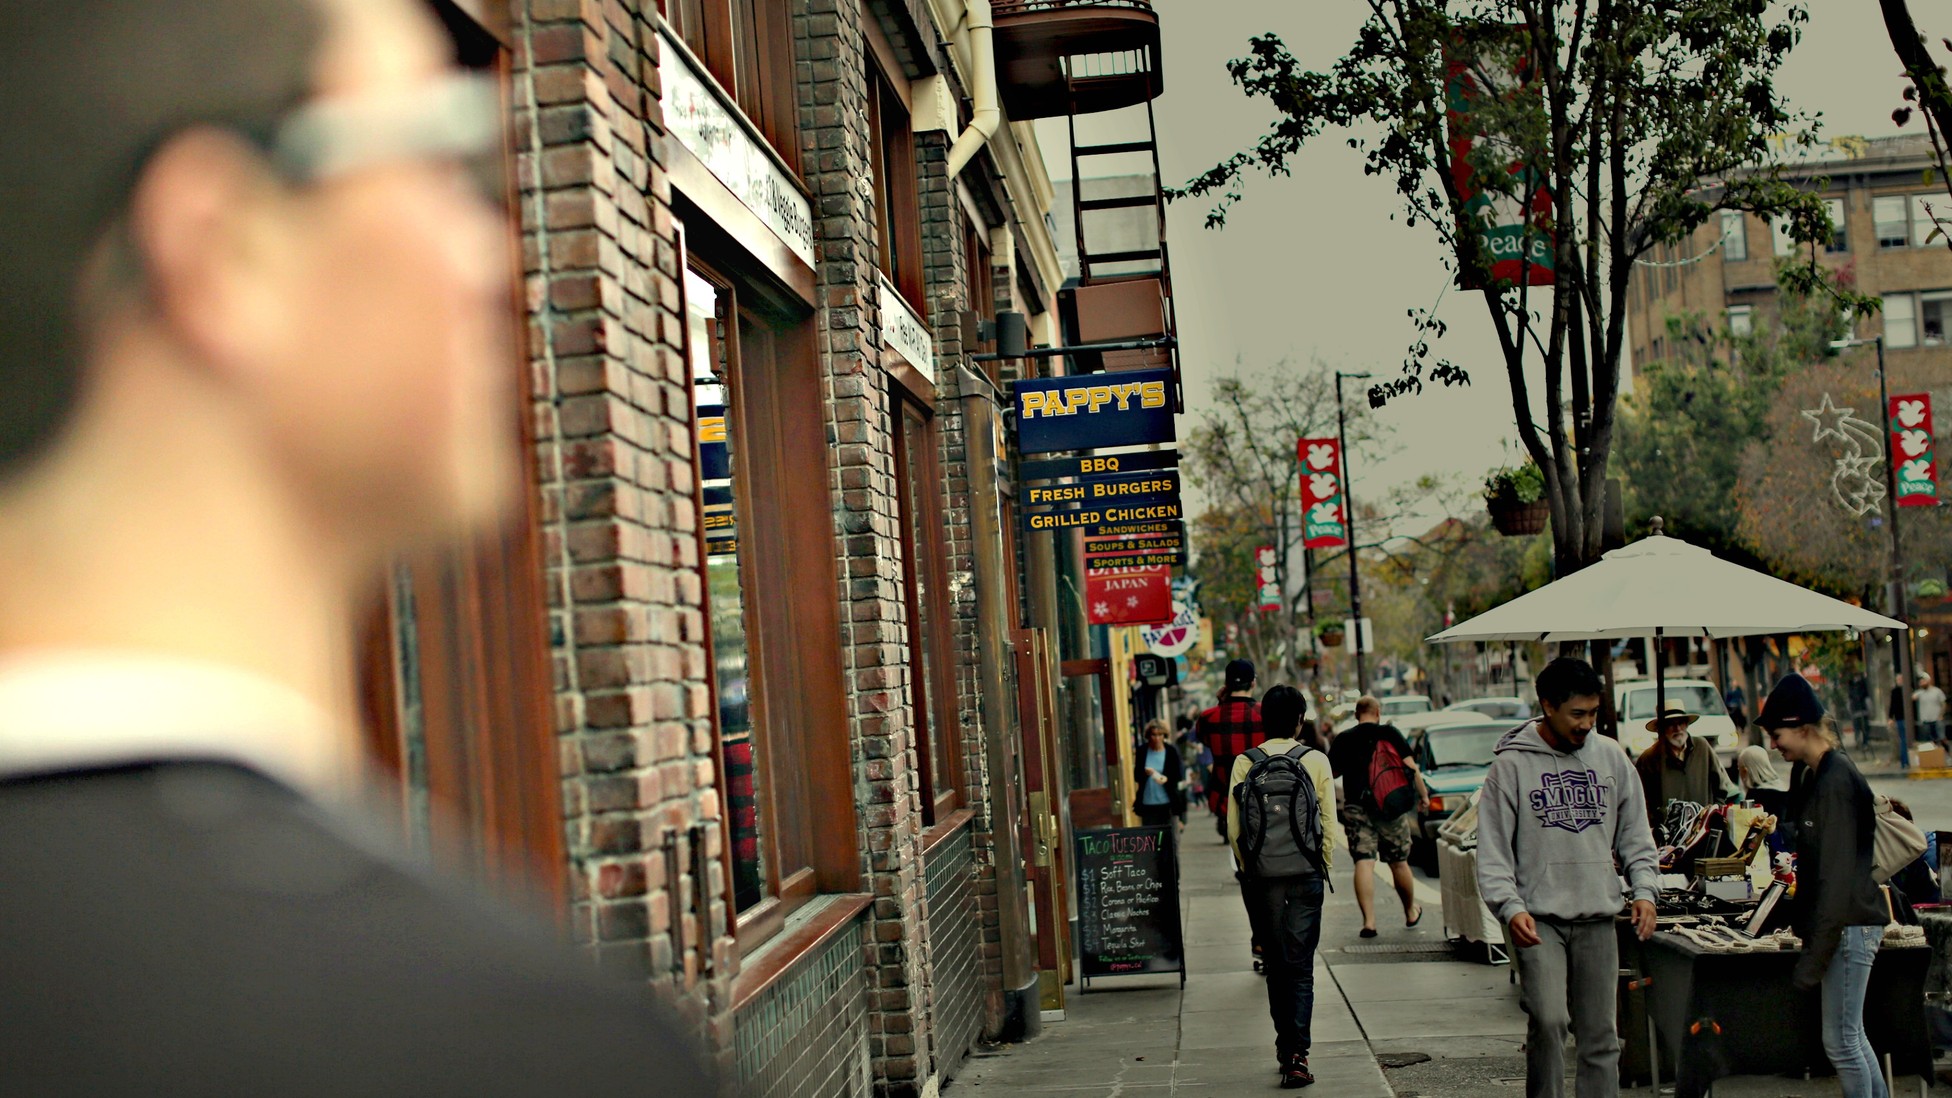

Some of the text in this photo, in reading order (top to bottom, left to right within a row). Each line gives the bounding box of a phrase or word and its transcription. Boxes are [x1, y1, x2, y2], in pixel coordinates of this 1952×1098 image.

[1021, 381, 1166, 419] PAPPY'S
[1080, 457, 1119, 473] BBQ
[1030, 479, 1172, 503] FRESH BURGERS
[1030, 504, 1178, 529] GRILLED CHICKEN
[1098, 523, 1168, 535] SANDWICHES
[1089, 539, 1180, 552] SOUPS & SALADS
[1093, 555, 1177, 568] SPORTS & MORE
[1104, 578, 1149, 592] JAPAN
[1529, 784, 1608, 811] SMOGON
[1100, 866, 1123, 880] Soft
[1124, 865, 1146, 877] Taco
